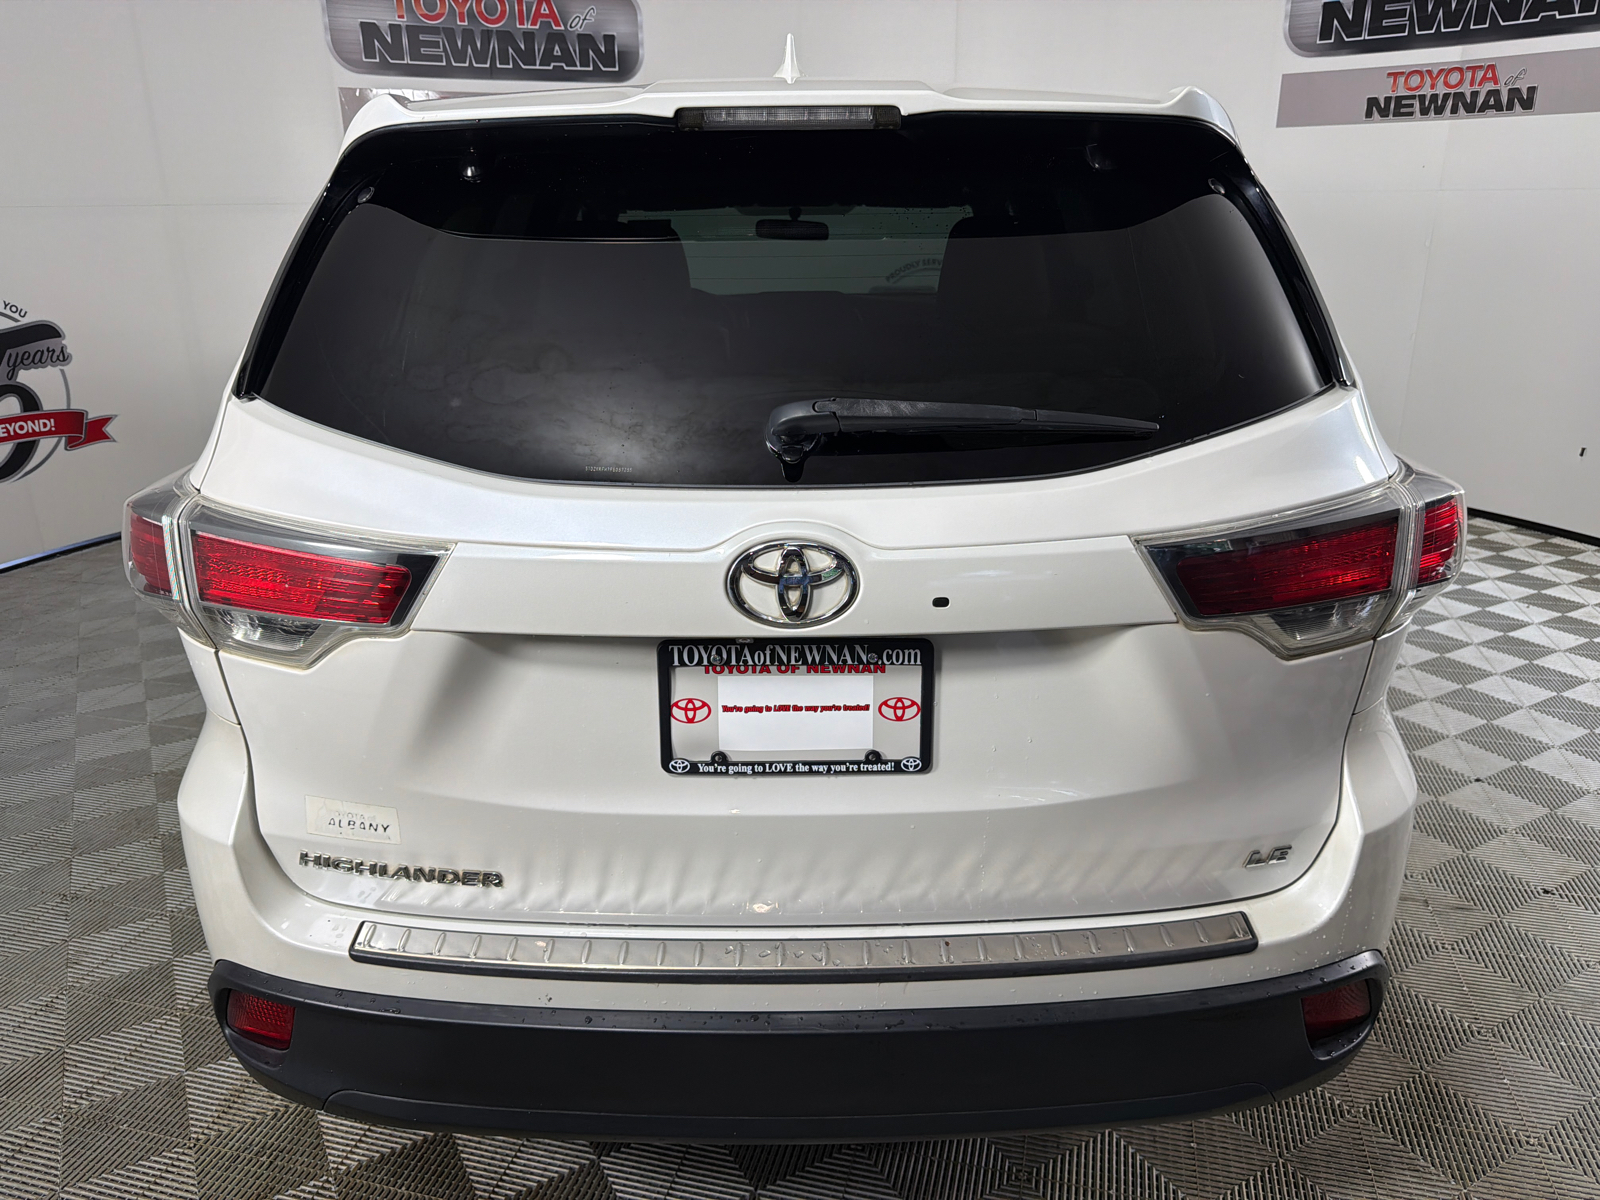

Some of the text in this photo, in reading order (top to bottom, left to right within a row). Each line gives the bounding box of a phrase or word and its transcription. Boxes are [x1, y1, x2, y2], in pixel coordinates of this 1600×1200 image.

[567, 7, 597, 31] of
[359, 20, 620, 71] NEWNAN
[1386, 62, 1527, 93] TOYOTA of
[1363, 84, 1539, 121] NEWNAN
[3, 300, 28, 318] YOU
[6, 345, 70, 381] years
[728, 764, 753, 774] going
[754, 764, 763, 773] to
[765, 763, 794, 773] LOVE
[795, 763, 809, 772] the
[811, 764, 829, 774] way
[860, 762, 895, 772] treated!
[328, 817, 391, 833] ALBANY
[299, 850, 504, 888] HIGHLANDER
[1242, 844, 1292, 868] LE
